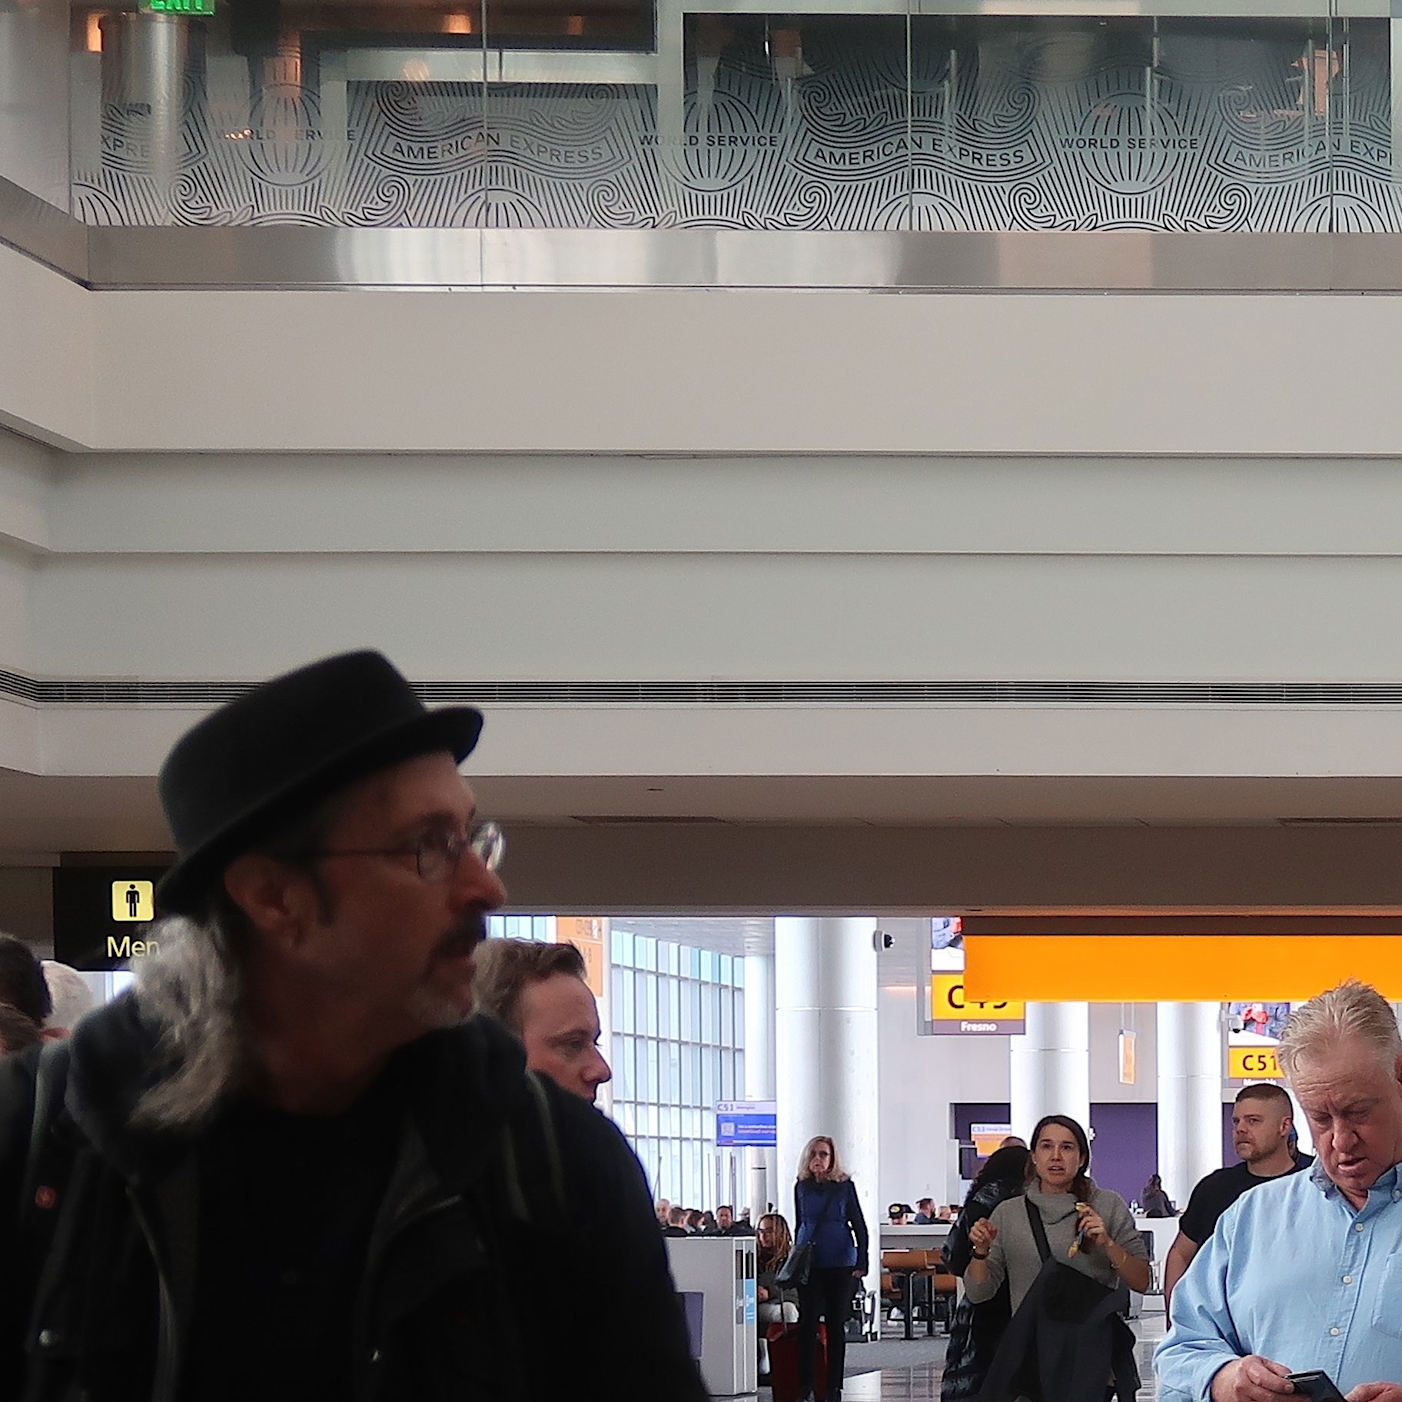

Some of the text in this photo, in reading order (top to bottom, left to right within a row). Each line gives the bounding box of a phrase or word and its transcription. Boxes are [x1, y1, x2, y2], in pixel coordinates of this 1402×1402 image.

[393, 132, 603, 163] AMERICAN EXPRESS
[706, 135, 779, 147] SERVICE
[1060, 137, 1199, 150] WORLD SERVICE
[814, 137, 1025, 167] AMERICAN EXPRESS
[1233, 138, 1342, 168] AMERICAN
[960, 1021, 998, 1032] Fresno
[1242, 1054, 1277, 1071] C51
